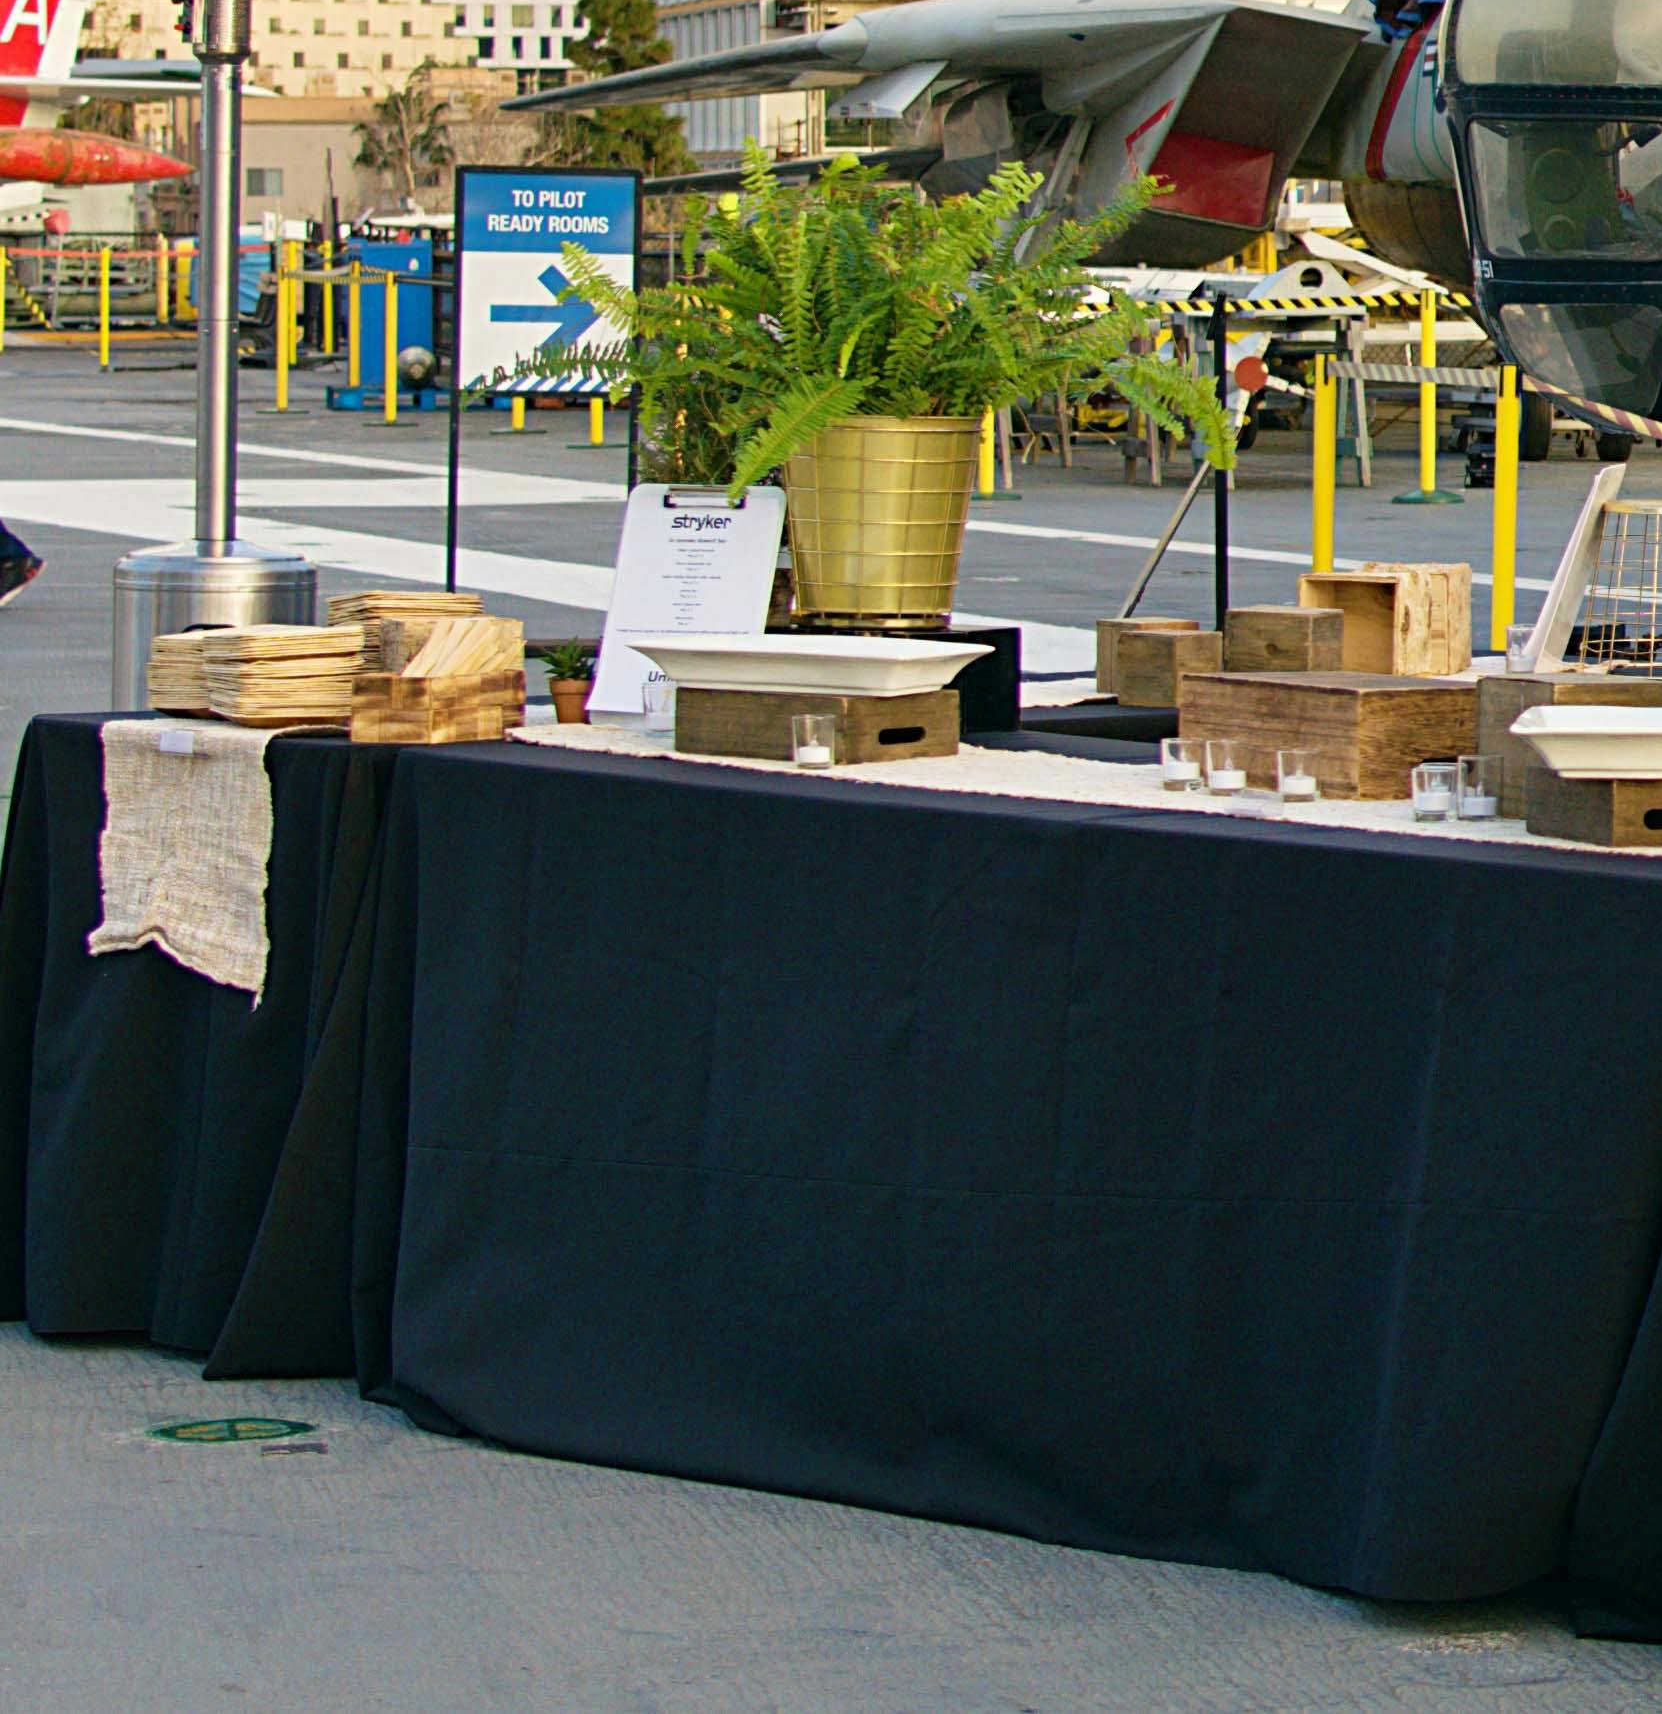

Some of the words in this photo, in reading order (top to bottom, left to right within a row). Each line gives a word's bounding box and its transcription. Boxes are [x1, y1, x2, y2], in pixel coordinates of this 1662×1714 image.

[512, 190, 535, 208] TO
[539, 190, 586, 209] PILOT
[487, 214, 544, 233] READY
[547, 216, 609, 234] ROOMS
[671, 514, 732, 531] stryker
